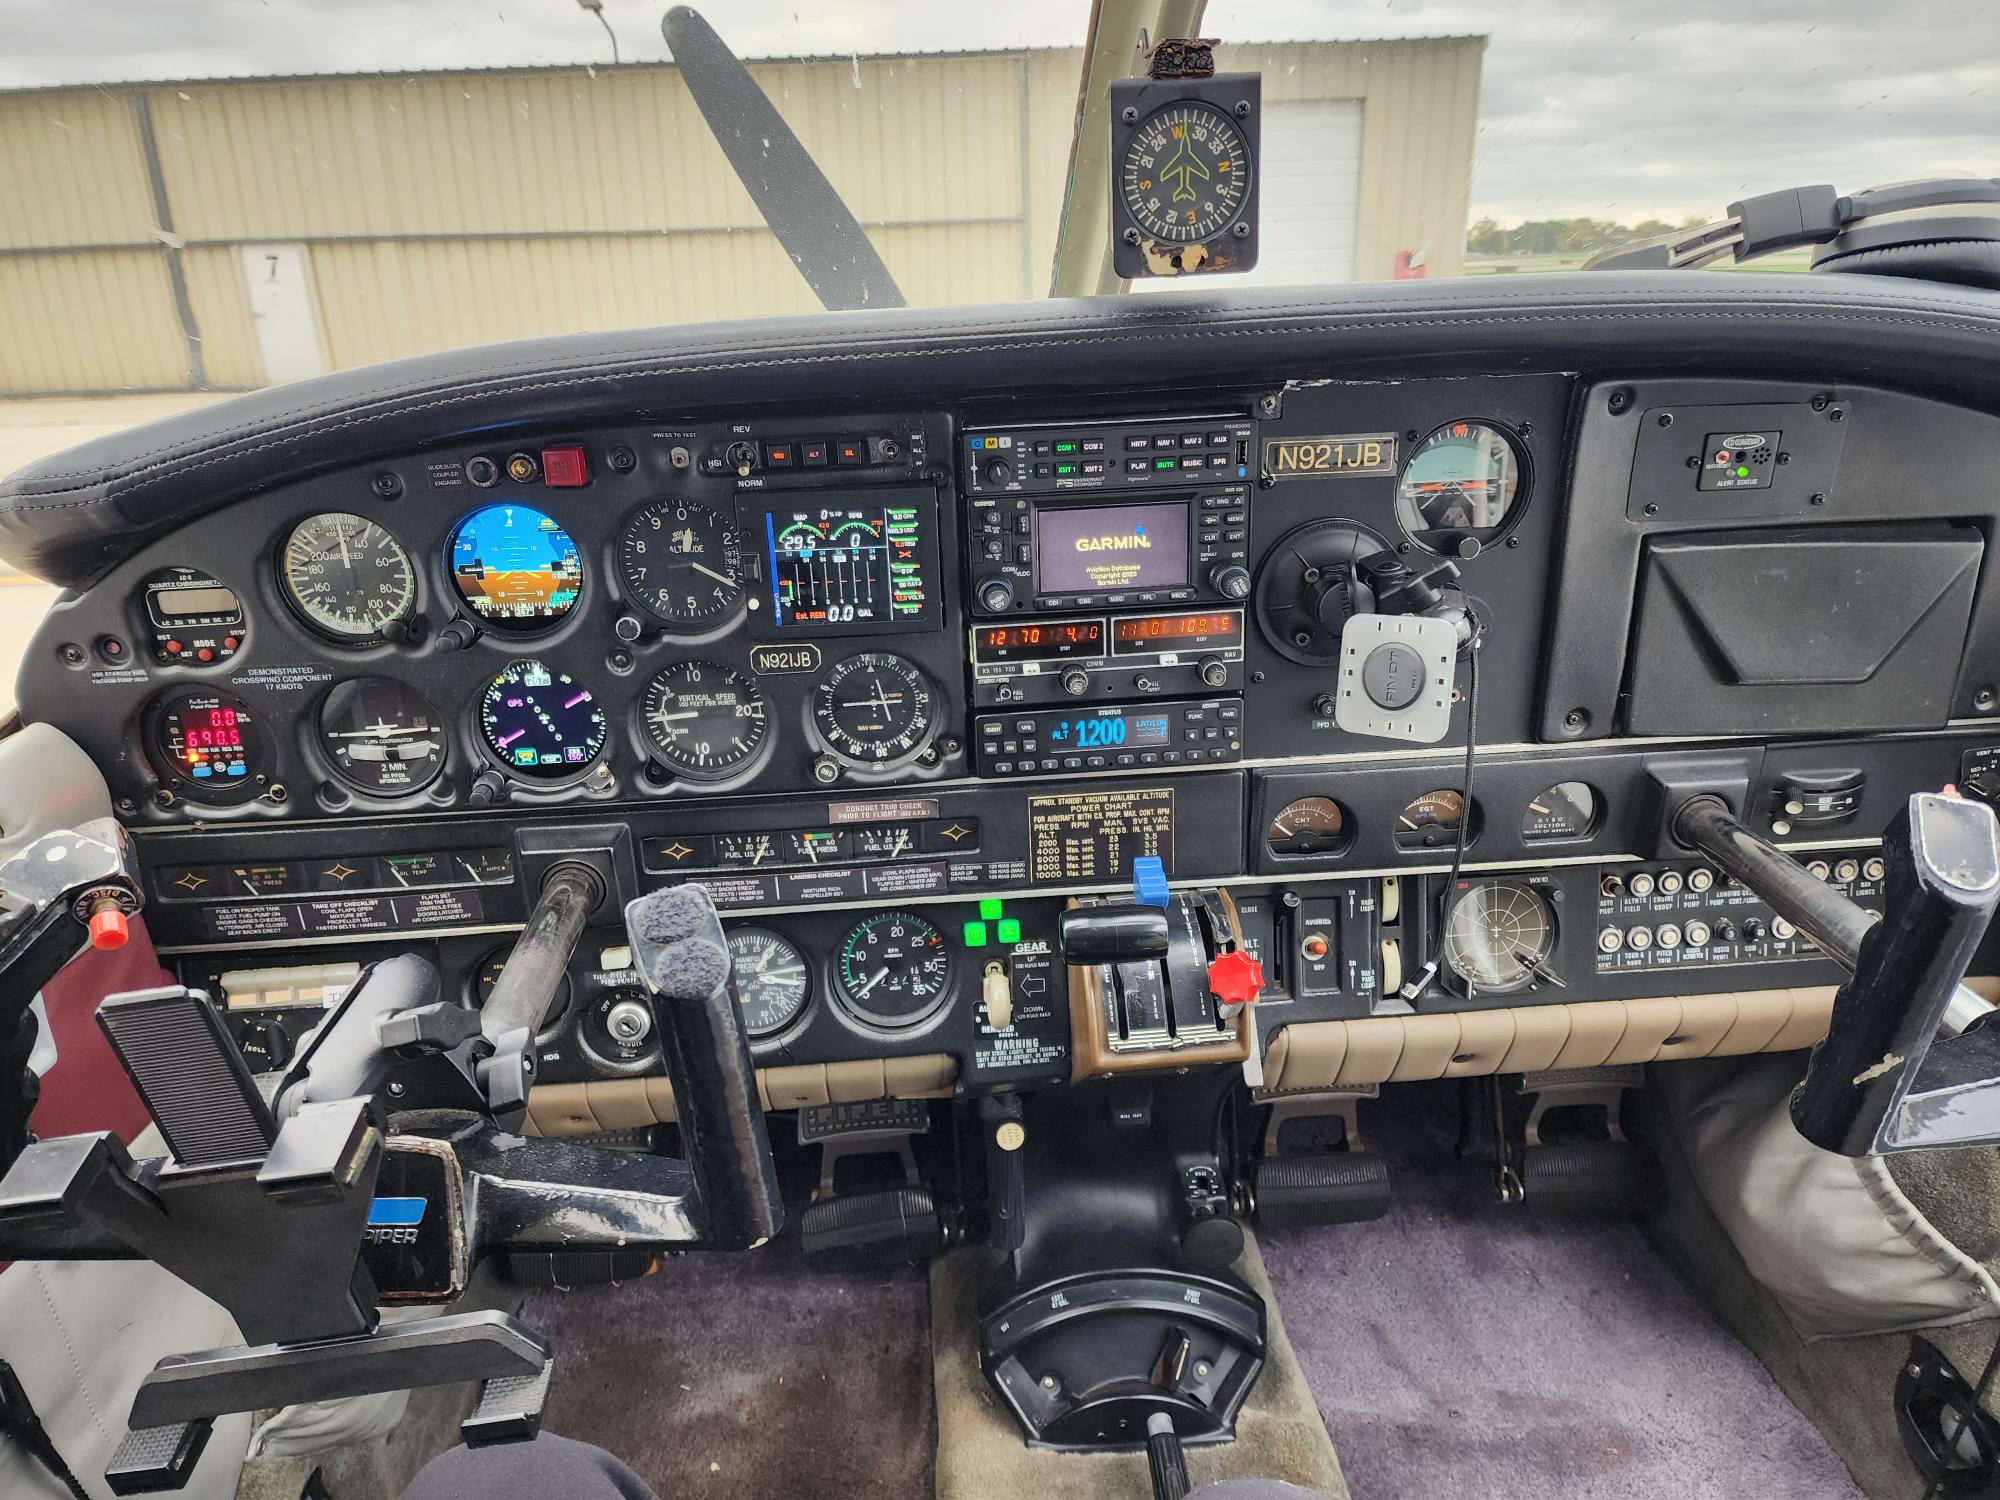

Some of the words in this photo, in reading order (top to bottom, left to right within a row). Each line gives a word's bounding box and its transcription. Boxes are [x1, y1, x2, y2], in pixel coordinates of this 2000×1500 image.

[1172, 126, 1183, 139] W
[1192, 126, 1208, 141] 30
[1151, 137, 1167, 152] 24
[1208, 138, 1225, 155] 33
[1140, 156, 1154, 168] 21
[1218, 161, 1230, 172] N
[1140, 180, 1152, 189] S
[1216, 184, 1229, 195] 3
[1146, 198, 1160, 212] 15
[1166, 210, 1177, 223] 12
[1187, 212, 1196, 223] E
[265, 255, 278, 283] 7
[733, 425, 750, 433] REV
[1278, 443, 1381, 470] N921JB
[707, 459, 722, 467] HSI
[738, 479, 763, 488] NORM
[355, 540, 367, 548] 40
[784, 536, 816, 549] 29.5
[851, 534, 860, 547] 0
[1075, 534, 1148, 552] GARMIN
[311, 552, 329, 561] 200
[376, 559, 389, 567] 60
[308, 566, 324, 574] 180
[1087, 566, 1111, 574] Aviation
[1090, 572, 1117, 581] Copyright
[314, 583, 330, 592] 160
[380, 584, 392, 593] 80
[368, 600, 383, 609] 100
[828, 605, 854, 622] 0.0
[858, 609, 873, 617] GAL
[248, 667, 314, 676] DEMONSTRATED
[686, 670, 700, 682] 10
[232, 676, 280, 684] CROSSWIND
[282, 674, 333, 683] COMPONENT
[507, 699, 523, 707] GPS
[678, 694, 710, 702] VERTICAL
[736, 705, 752, 717] 20
[211, 709, 235, 726] 0.0
[1052, 729, 1069, 740] ALT
[1076, 718, 1126, 747] 1200
[695, 743, 710, 755] 10
[388, 763, 408, 771] MIN.
[1058, 797, 1083, 806] STANDBY
[1085, 795, 1108, 804] VACUUM
[1110, 793, 1140, 802] AVAILABLE
[1142, 791, 1170, 800] ALTITUDE
[846, 804, 879, 813] CONDUCT
[881, 803, 898, 811] TRIM
[899, 802, 922, 810] CHECK
[1071, 804, 1100, 813] POWER
[1104, 801, 1133, 810] CHART
[1419, 805, 1436, 813] EGT
[838, 812, 858, 820] PRIOR
[873, 810, 897, 818] FLIGHT
[1033, 815, 1046, 824] FOR
[1047, 813, 1075, 822] AIRCRAFT
[1077, 812, 1092, 821] WITH
[1105, 811, 1122, 819] PROP.
[1124, 810, 1137, 818] MAX.
[1139, 808, 1155, 817] CONT.
[1157, 807, 1170, 815] RPM
[1034, 823, 1061, 831] PRESS.
[1071, 821, 1090, 829] RPM
[1104, 819, 1125, 827] MAN.
[1132, 817, 1148, 825] SVS
[1152, 815, 1170, 824] VAC.
[1038, 831, 1057, 839] ALT.
[1099, 827, 1129, 835] PRESS.
[1038, 839, 1058, 847] 2000
[1066, 838, 1080, 846] Max.
[1081, 837, 1095, 845] cont.
[1037, 847, 1060, 855] 4000
[1066, 846, 1080, 854] Max.
[1081, 845, 1095, 853] cont.
[1109, 843, 1120, 851] 22
[1066, 854, 1080, 862] Max.
[1081, 853, 1095, 861] cont.
[1037, 863, 1060, 871] 8000
[1066, 862, 1080, 870] Max.
[1081, 861, 1095, 869] cont.
[1036, 871, 1062, 879] 10000
[1066, 870, 1080, 878] Max.
[1081, 869, 1095, 877] cont.
[1109, 867, 1118, 875] 17
[1716, 890, 1741, 898] LANDING
[1856, 888, 1876, 896] LIGHTS
[891, 927, 904, 937] 20
[868, 934, 877, 944] 15
[911, 936, 924, 947] 25
[1244, 939, 1260, 949] ALT.
[1015, 942, 1048, 953] GEAR
[856, 951, 866, 961] 10
[924, 962, 938, 972] 30
[859, 973, 867, 984] 5
[912, 985, 925, 995] 35
[600, 1000, 611, 1013] OFF
[994, 1038, 1039, 1050] WARNING
[543, 1053, 560, 1062] HDG
